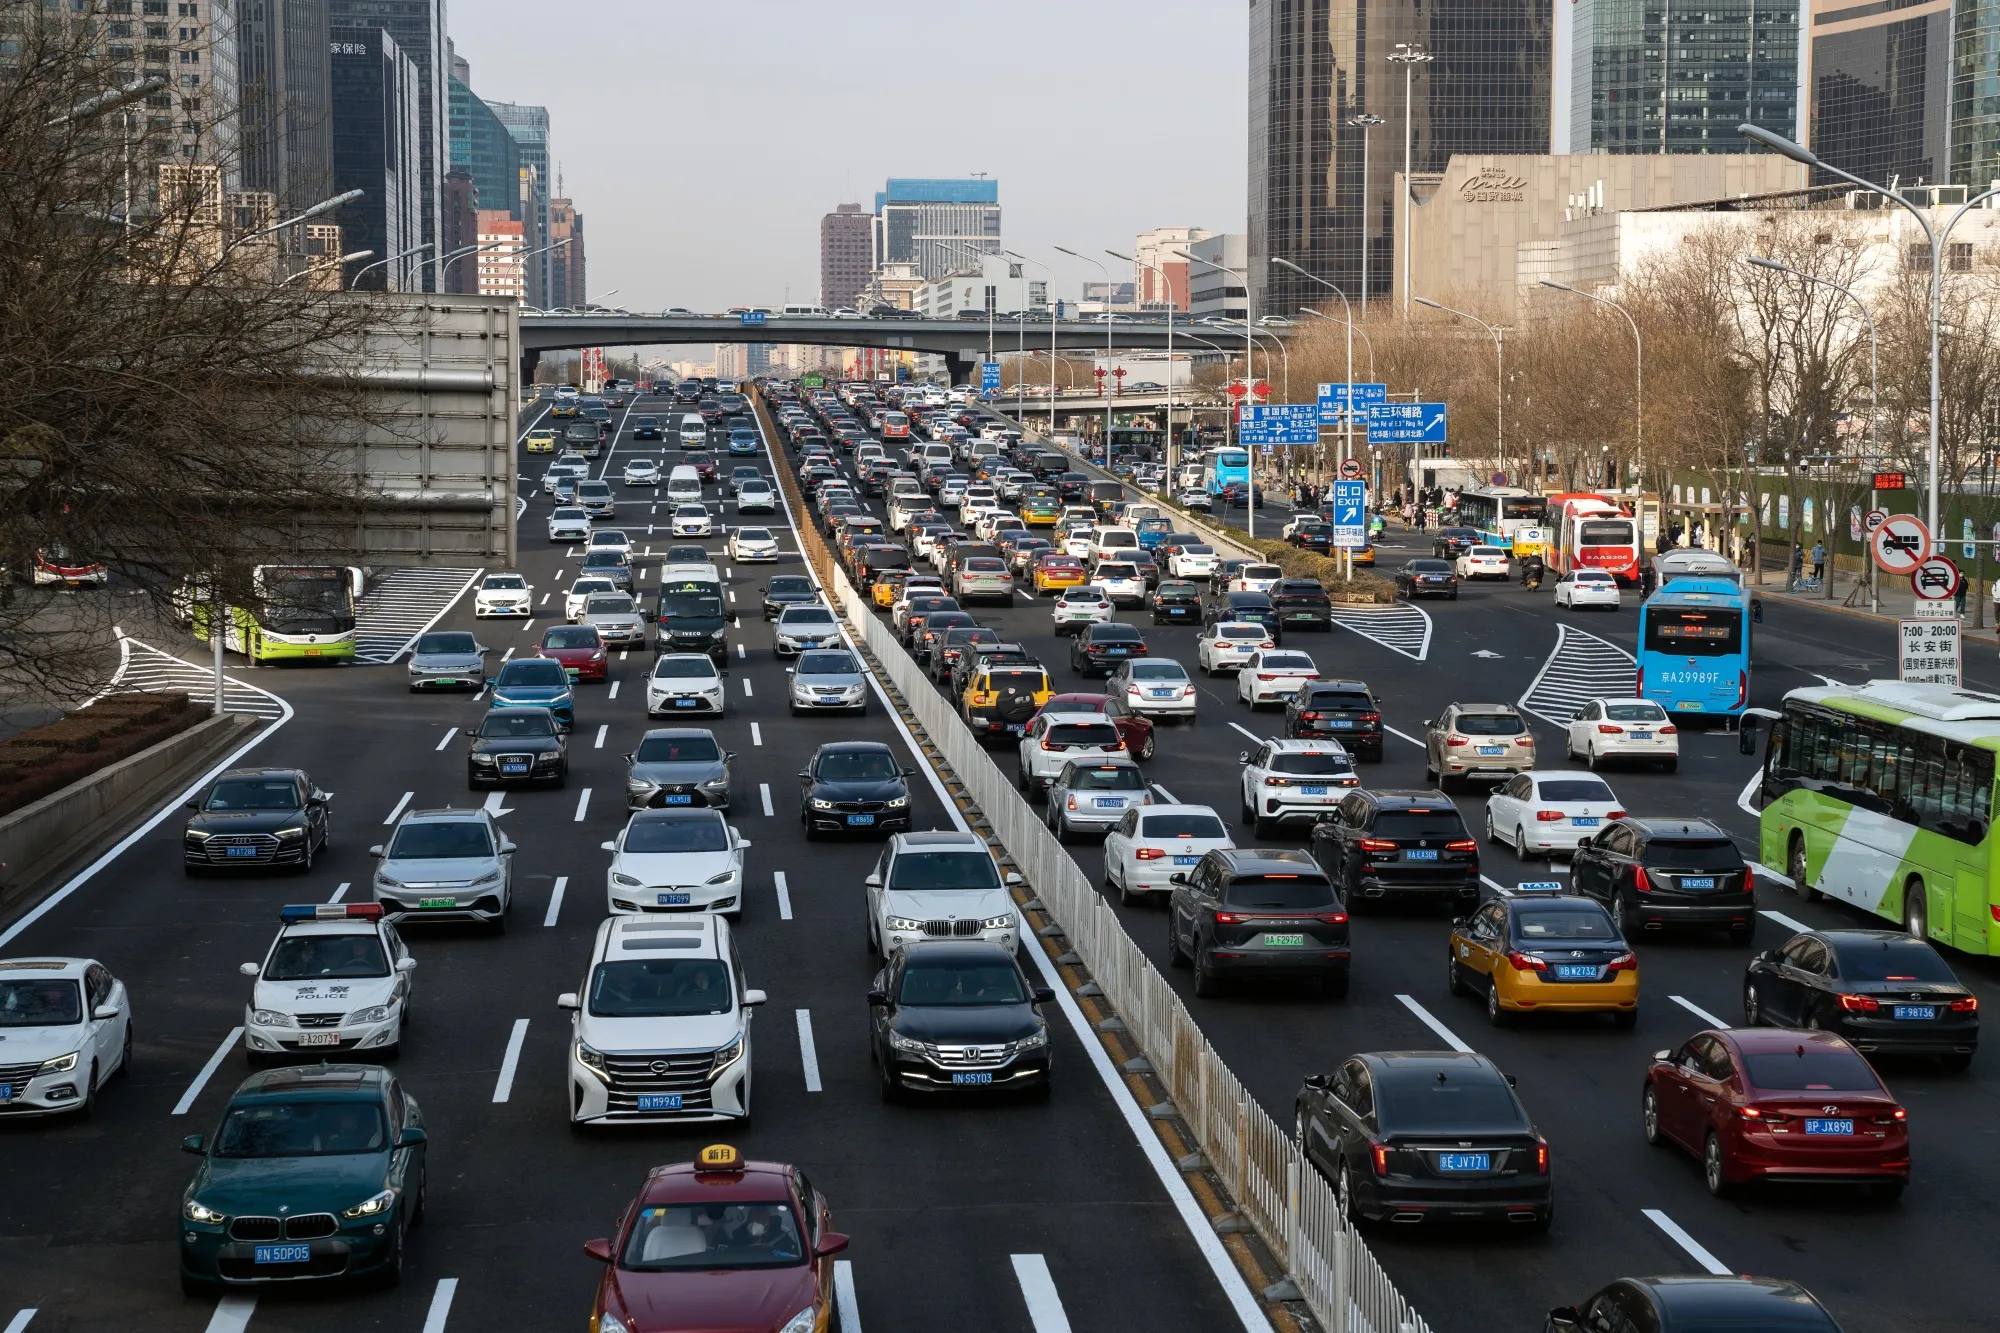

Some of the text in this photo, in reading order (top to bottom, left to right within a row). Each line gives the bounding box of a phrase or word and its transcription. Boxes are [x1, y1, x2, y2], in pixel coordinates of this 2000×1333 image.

[1370, 407, 1422, 418] 东三环辅路
[1290, 420, 1316, 428] 东北三环
[1337, 485, 1361, 496] 出口
[1908, 641, 1952, 652] 长安街
[1661, 672, 1719, 683] 京A29989F
[708, 1150, 729, 1160] 新月
